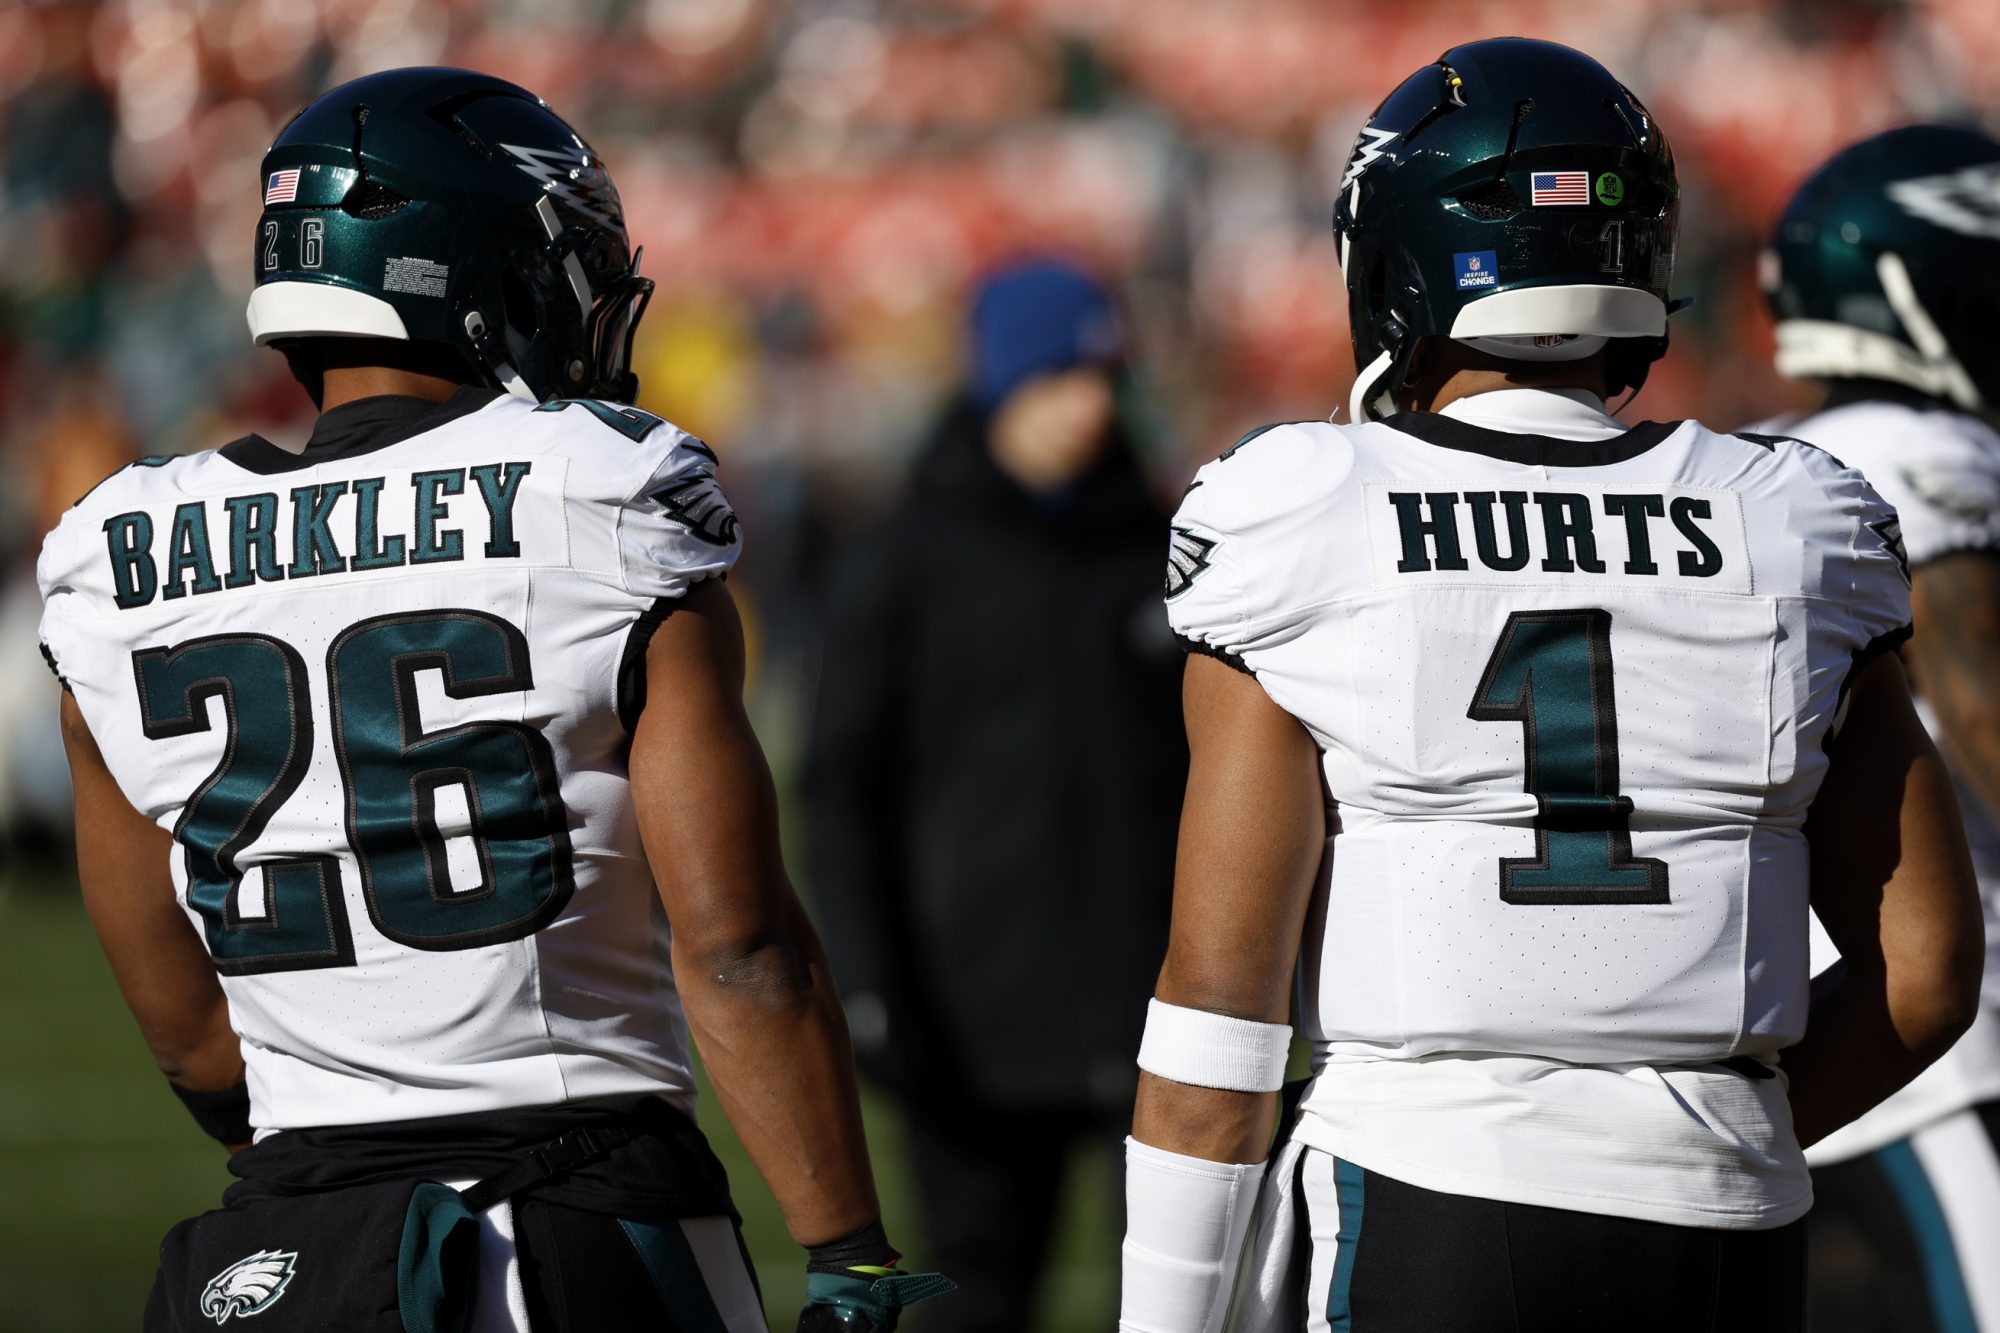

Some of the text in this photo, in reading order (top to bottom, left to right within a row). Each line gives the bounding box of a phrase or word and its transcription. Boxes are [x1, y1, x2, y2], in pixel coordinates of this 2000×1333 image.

[402, 256, 434, 264] WARNING
[1463, 270, 1489, 278] INSPIRE
[1599, 220, 1624, 272] 1
[1459, 275, 1495, 287] CHANGE
[102, 461, 531, 609] BARKLEY
[1388, 491, 1724, 577] HURTS
[1466, 608, 1671, 905] 1
[132, 608, 574, 976] 26
